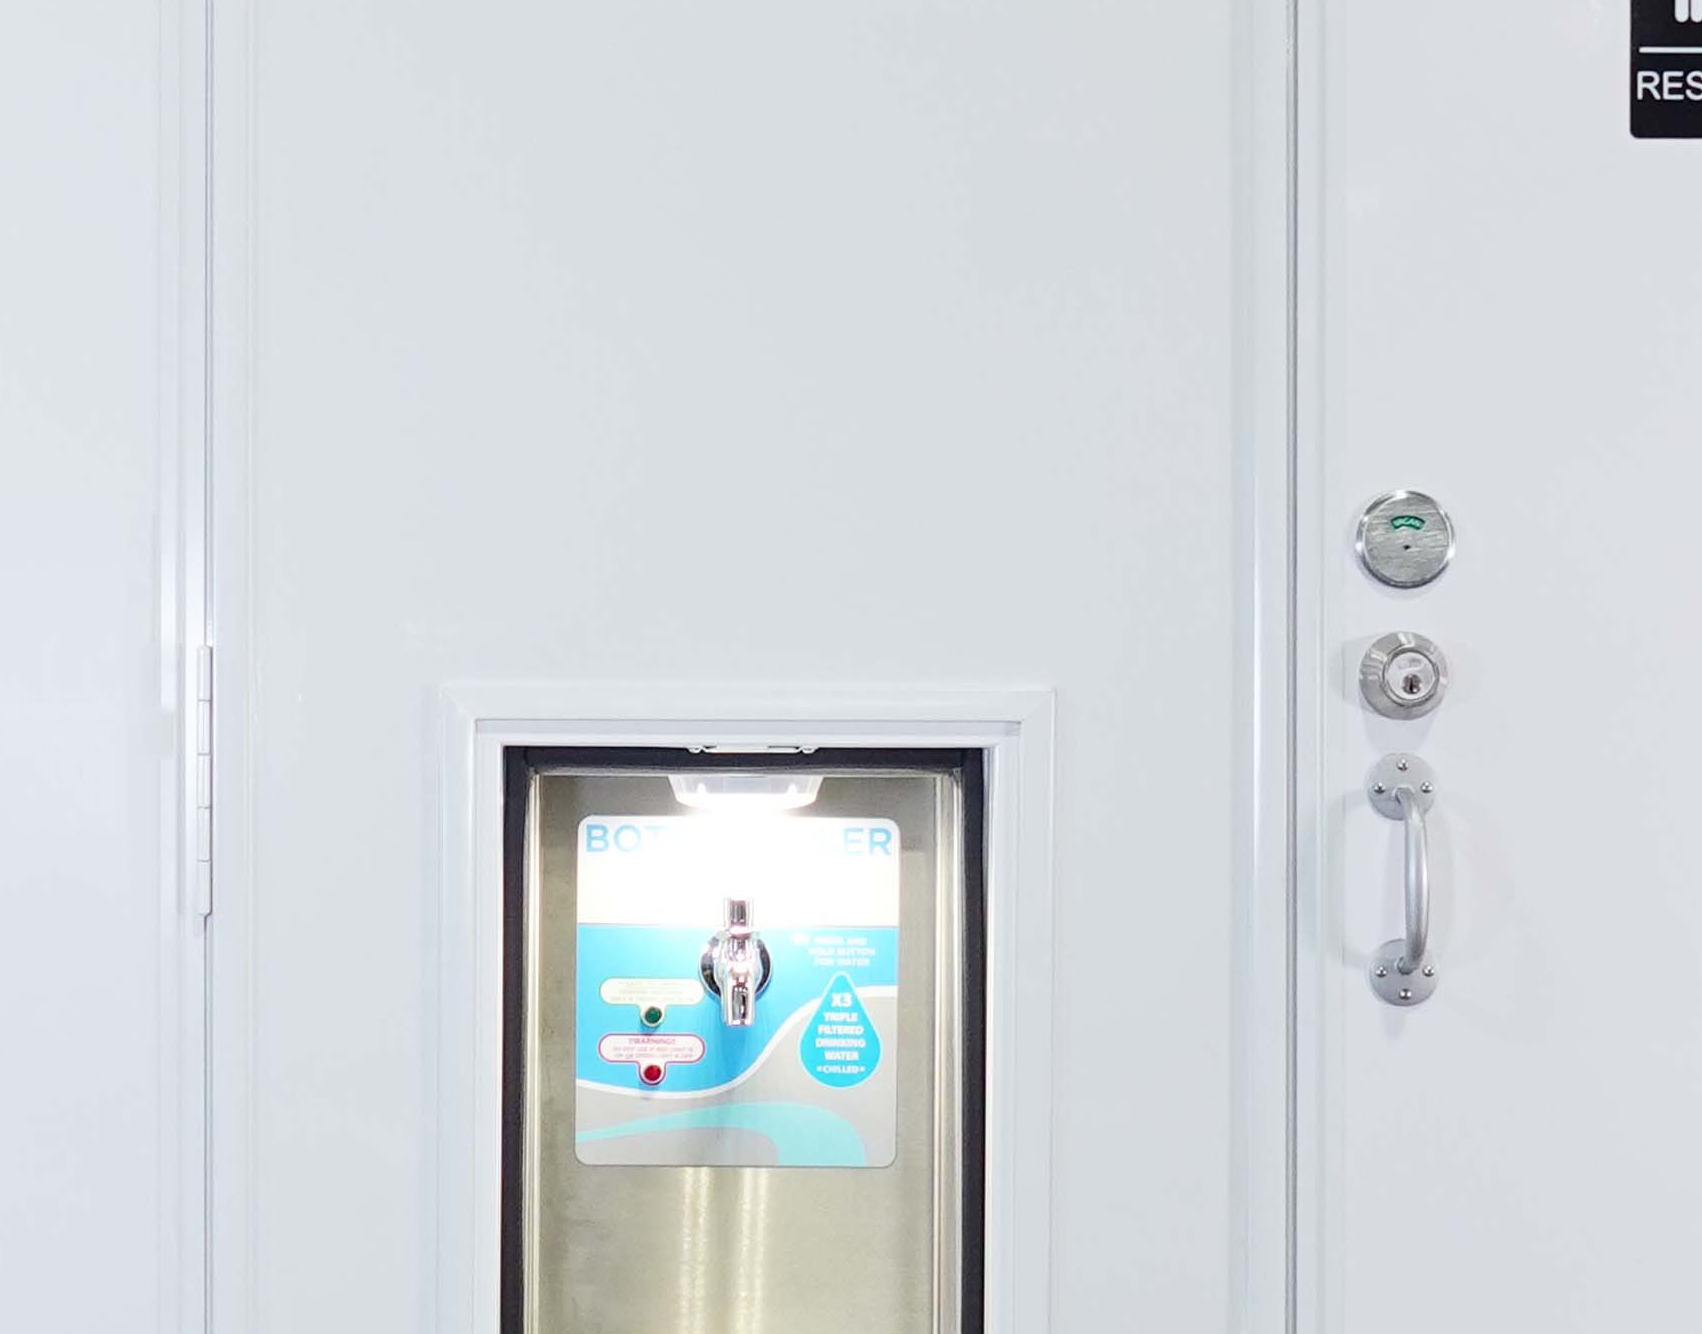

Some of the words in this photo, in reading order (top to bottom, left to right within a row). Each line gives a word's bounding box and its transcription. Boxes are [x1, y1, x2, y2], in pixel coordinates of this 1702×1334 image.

[831, 993, 853, 1008] X3
[823, 1012, 859, 1022] TRIPLE
[817, 1025, 865, 1035] FILTERED
[815, 1038, 866, 1048] DRINKING
[823, 1050, 860, 1061] WATER
